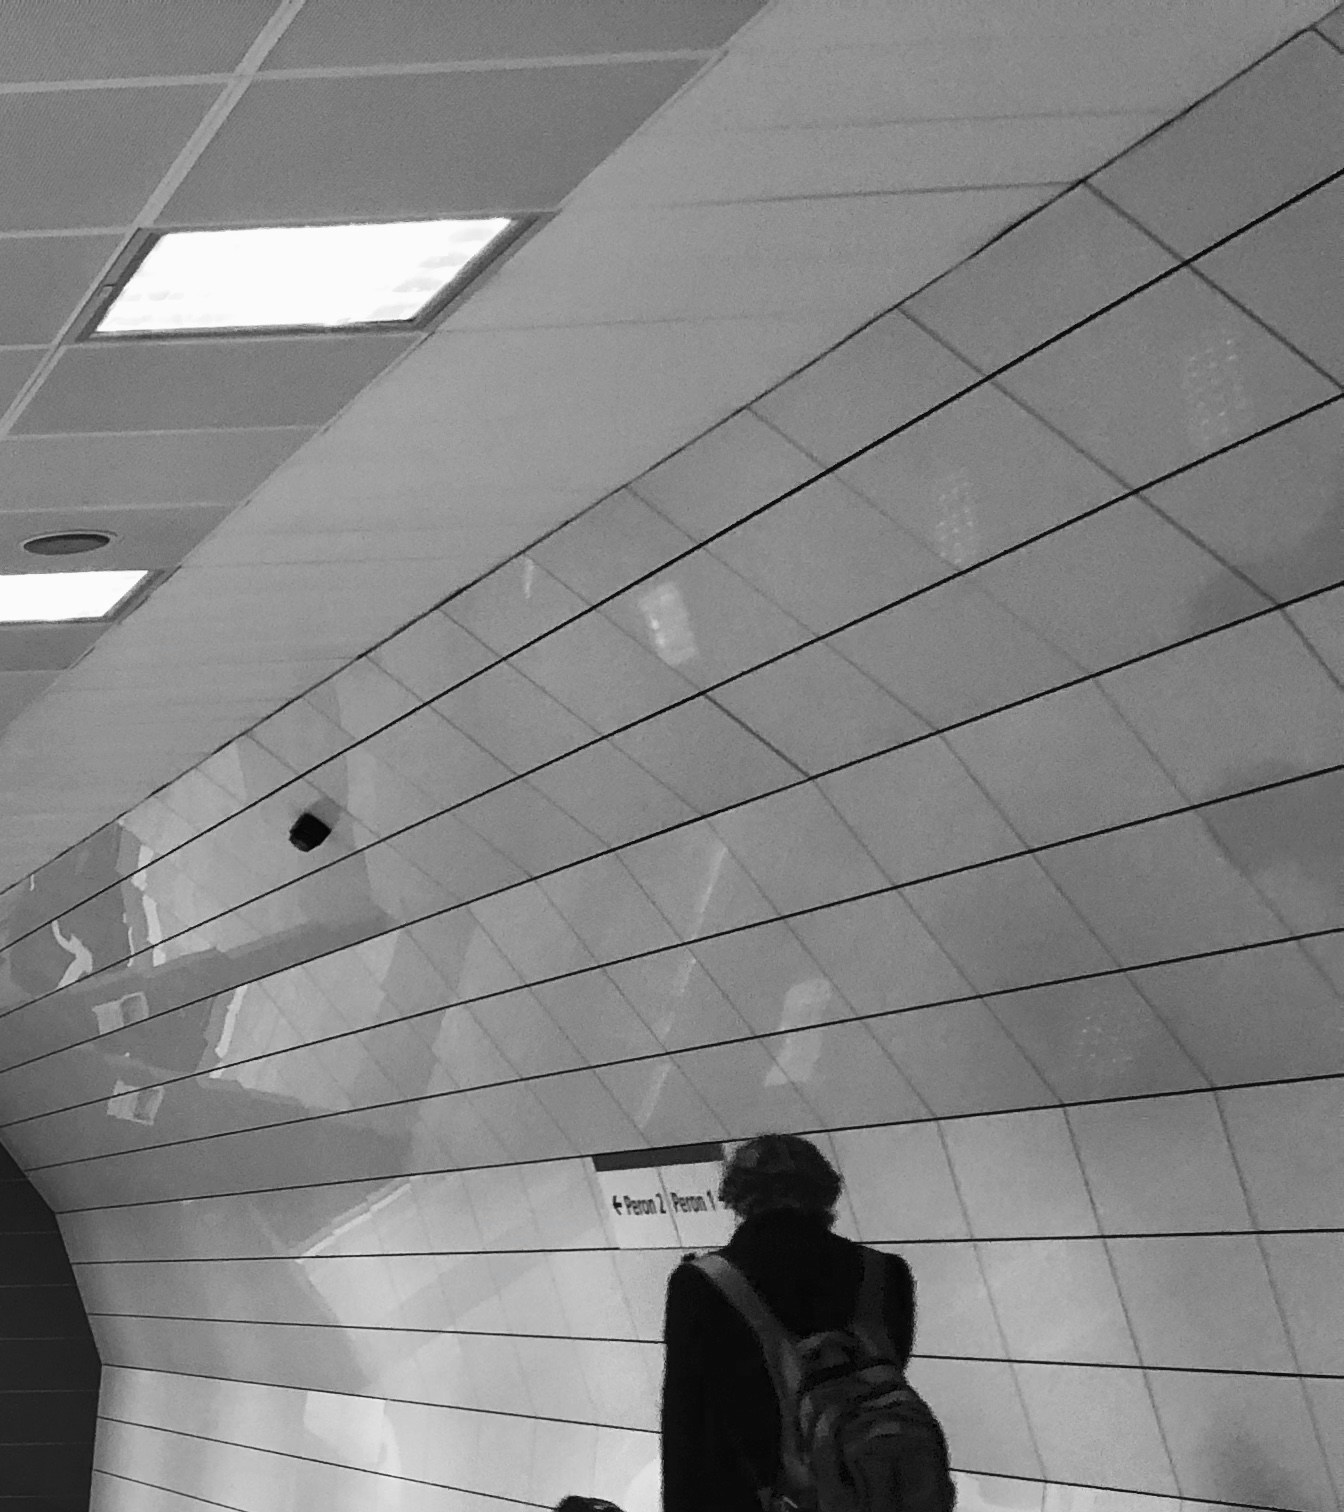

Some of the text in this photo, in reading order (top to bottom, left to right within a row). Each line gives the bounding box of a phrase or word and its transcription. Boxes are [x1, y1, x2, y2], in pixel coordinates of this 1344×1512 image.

[623, 1191, 666, 1215] Peron 2
[671, 1189, 716, 1214] Peron 1
